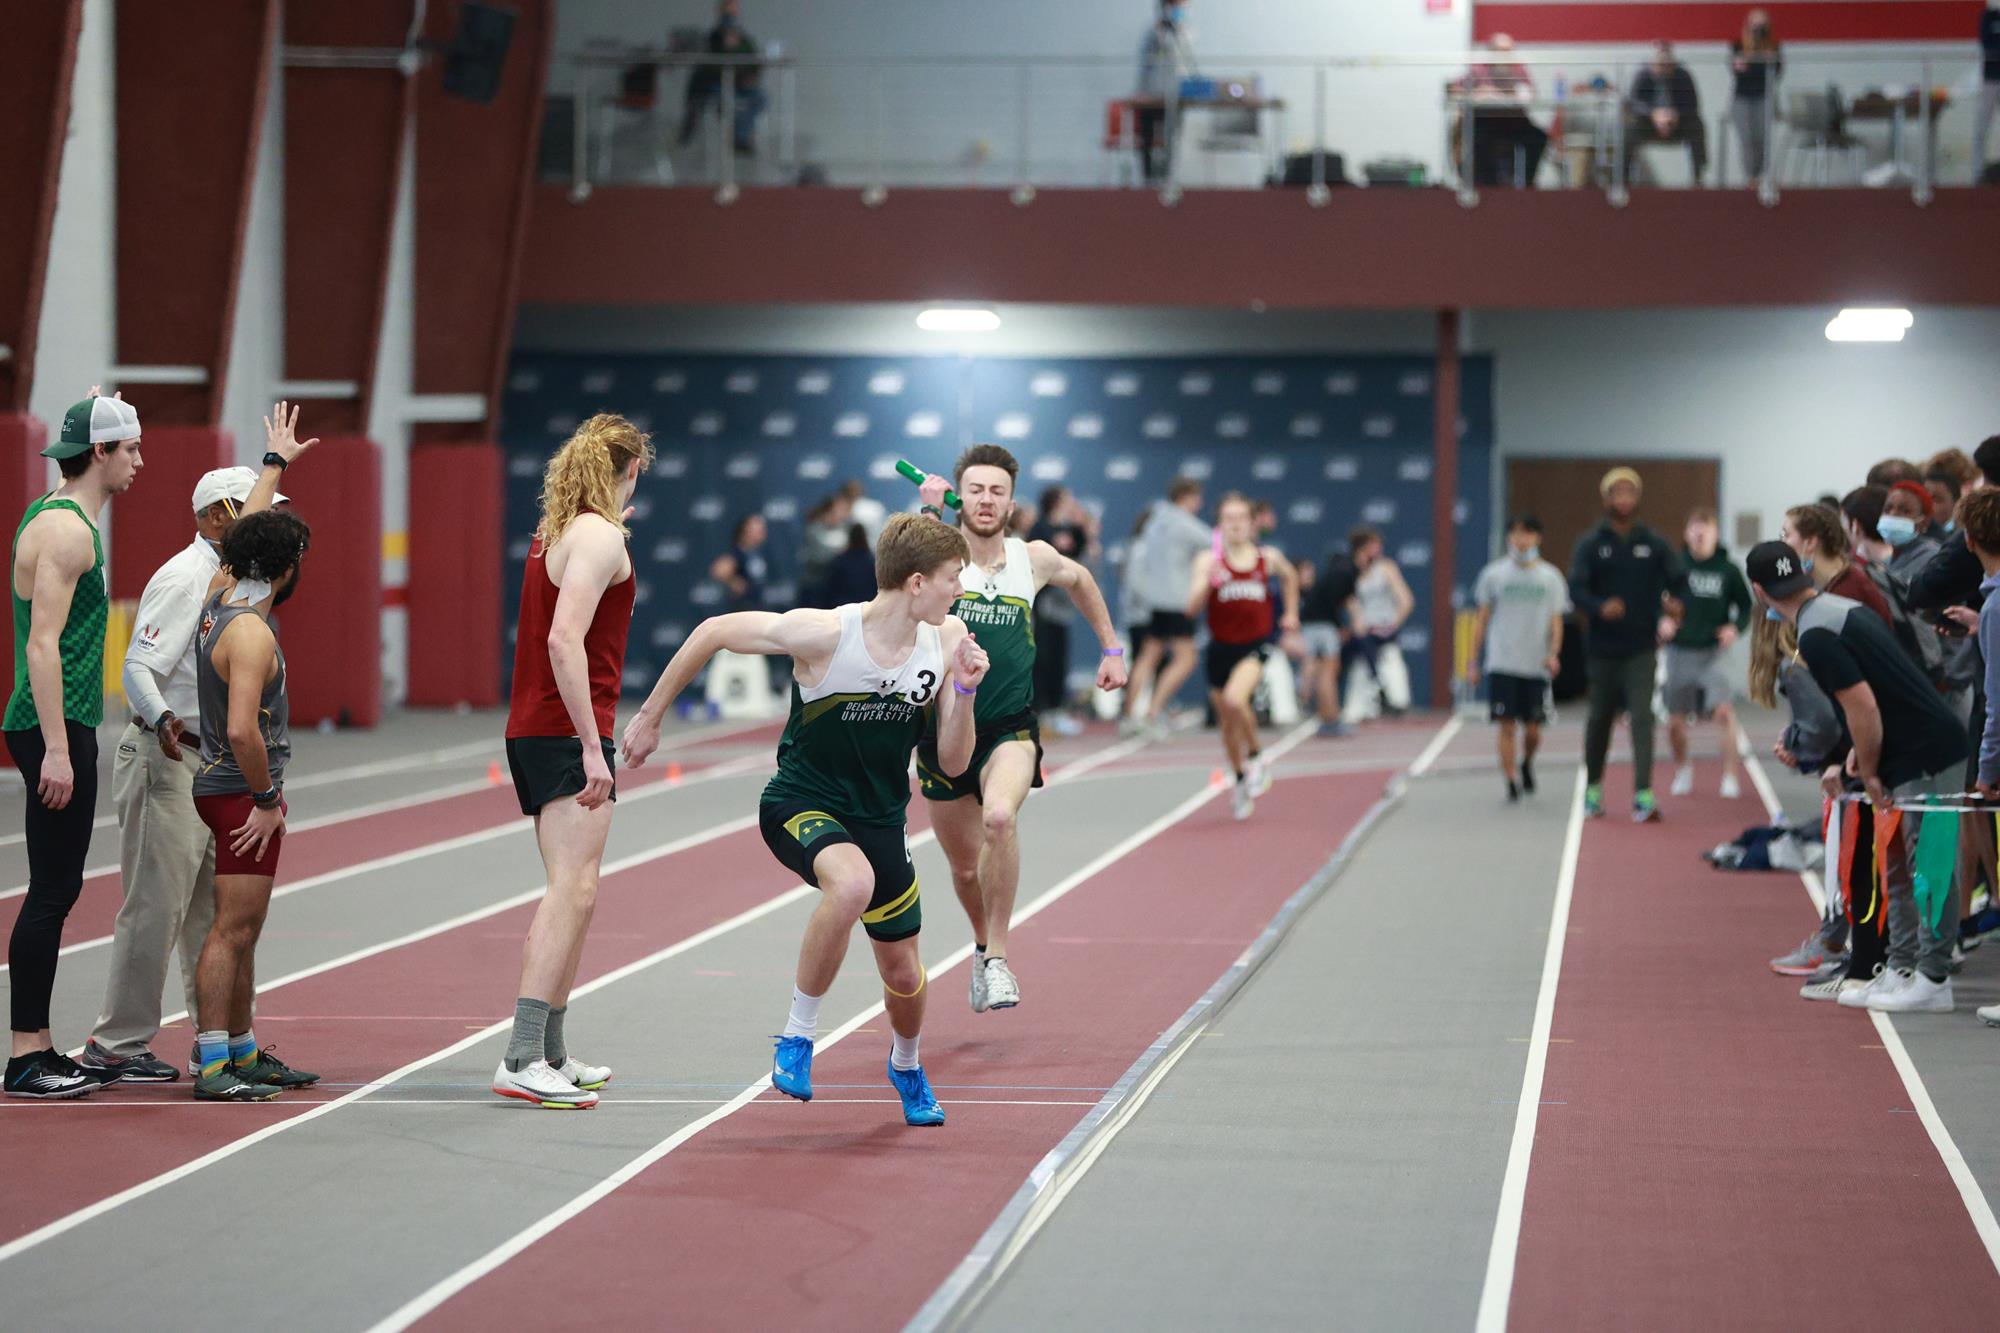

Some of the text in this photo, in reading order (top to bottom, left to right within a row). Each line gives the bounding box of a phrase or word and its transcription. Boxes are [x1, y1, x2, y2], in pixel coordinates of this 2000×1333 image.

[958, 599, 1020, 615] DELAWARE VALLEY
[956, 609, 1017, 626] UNIVERSITY
[911, 669, 936, 703] 3
[845, 701, 888, 712] DELAWARE
[841, 710, 912, 723] UNIVERSITY
